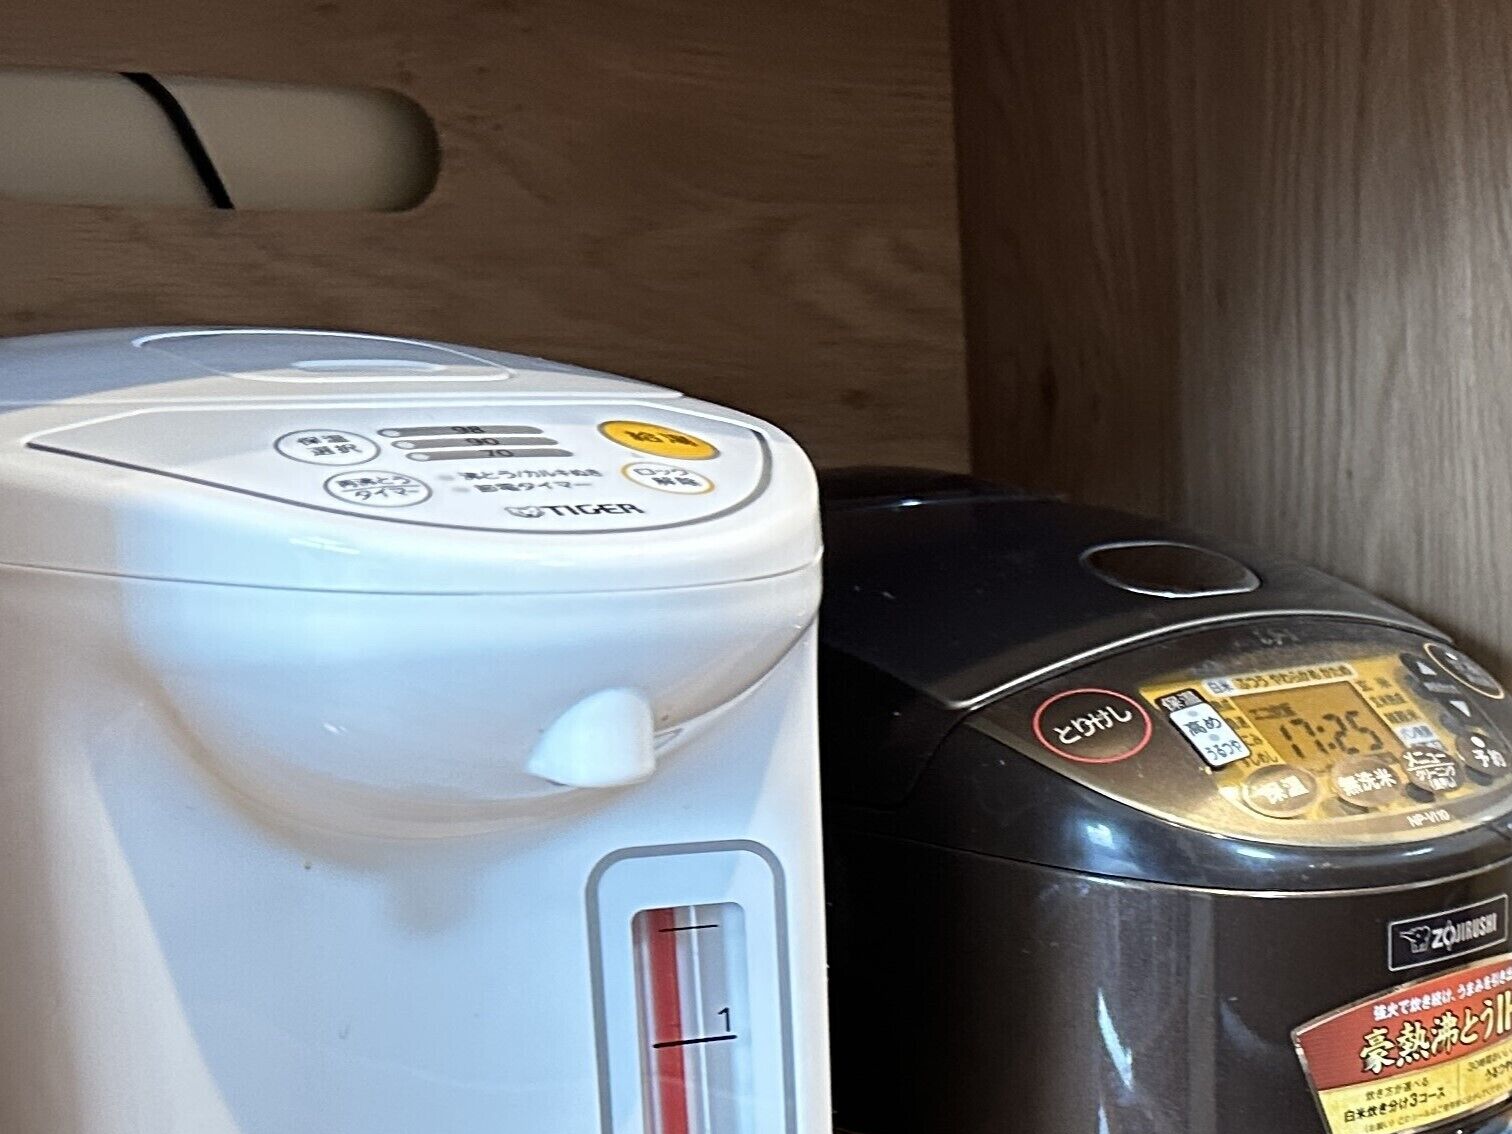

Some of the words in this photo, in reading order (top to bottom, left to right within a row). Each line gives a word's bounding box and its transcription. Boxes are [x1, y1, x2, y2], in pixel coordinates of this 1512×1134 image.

[451, 425, 485, 434] 98
[297, 434, 350, 445] 保温
[465, 437, 500, 446] 90
[308, 444, 363, 456] 選択
[479, 449, 514, 457] 70
[633, 468, 689, 476] ロック
[355, 485, 419, 500] タイマー
[540, 503, 645, 516] TIGER
[1052, 706, 1133, 744] とりけし
[1183, 716, 1222, 736] 高め
[1280, 710, 1383, 759] 17:25
[1204, 740, 1242, 761] うるつや
[1402, 750, 1447, 768] メニュー
[1337, 767, 1398, 797] 無洗米
[1431, 912, 1497, 952] ZOJIRUSHI
[717, 1007, 731, 1032] 1
[1343, 1086, 1446, 1123] 白米炊き分け3コース
